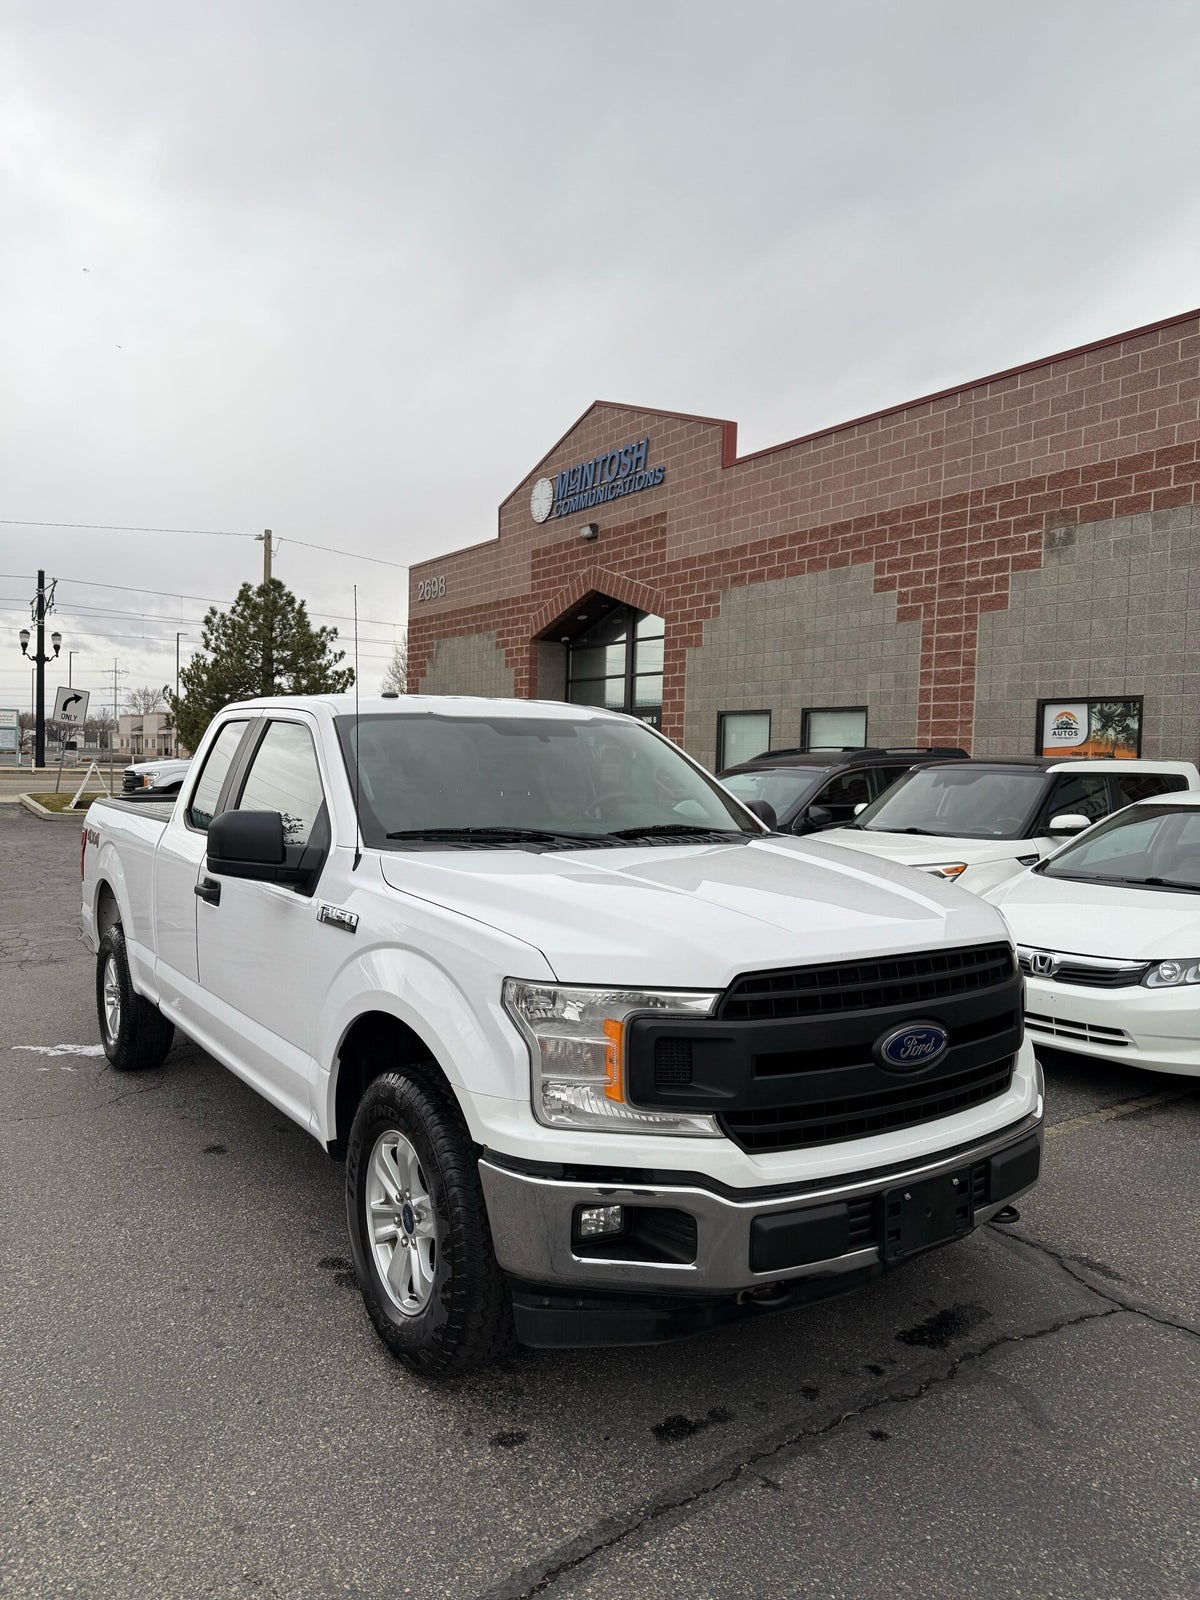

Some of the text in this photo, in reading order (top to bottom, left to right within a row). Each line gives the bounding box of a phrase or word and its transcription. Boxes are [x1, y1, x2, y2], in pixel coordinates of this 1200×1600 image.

[553, 465, 666, 518] COMMUNICATIONS
[418, 576, 446, 602] 2698
[60, 712, 78, 722] ONLY
[900, 1033, 935, 1059] Ford
